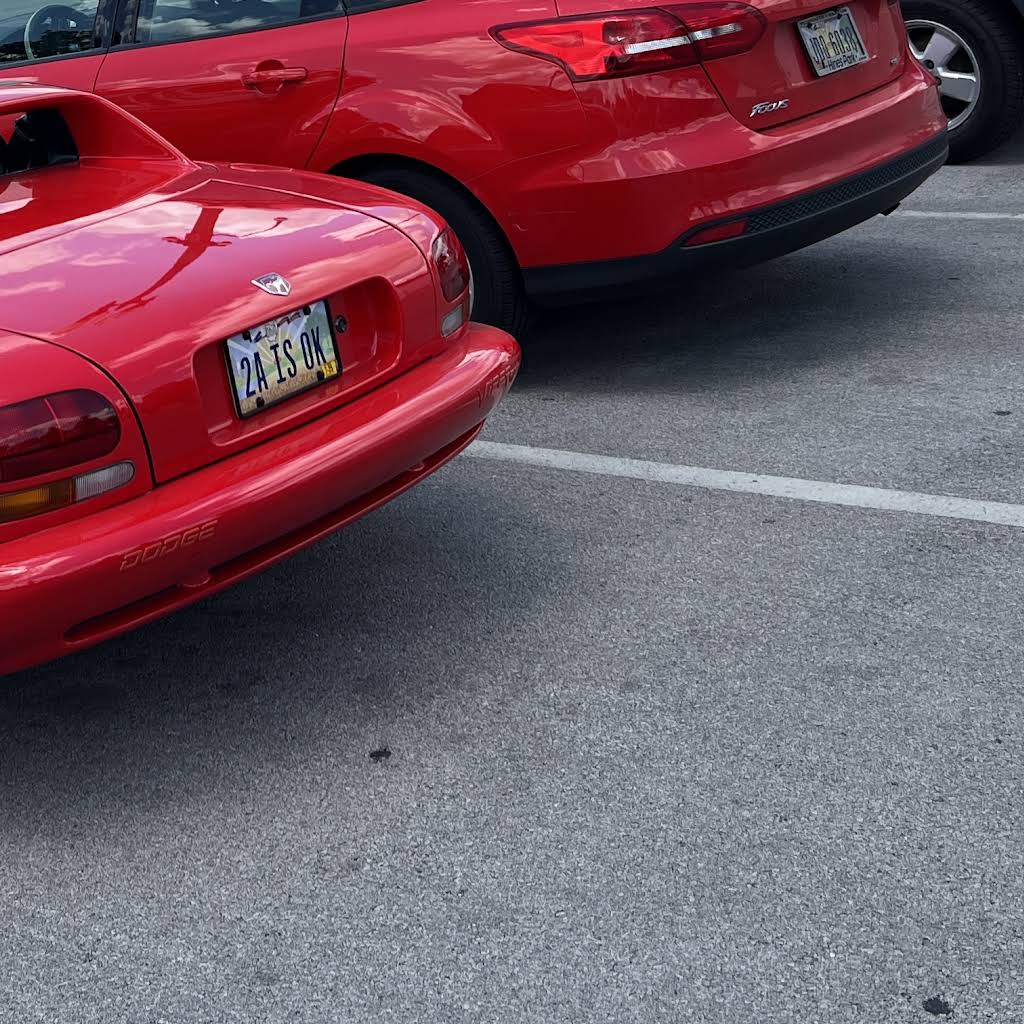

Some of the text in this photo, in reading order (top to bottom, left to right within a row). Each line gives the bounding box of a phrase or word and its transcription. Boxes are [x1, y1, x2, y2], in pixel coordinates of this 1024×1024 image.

[240, 351, 269, 398] 2A
[270, 338, 298, 384] IS
[300, 325, 328, 370] OK
[119, 519, 218, 572] DODGE
